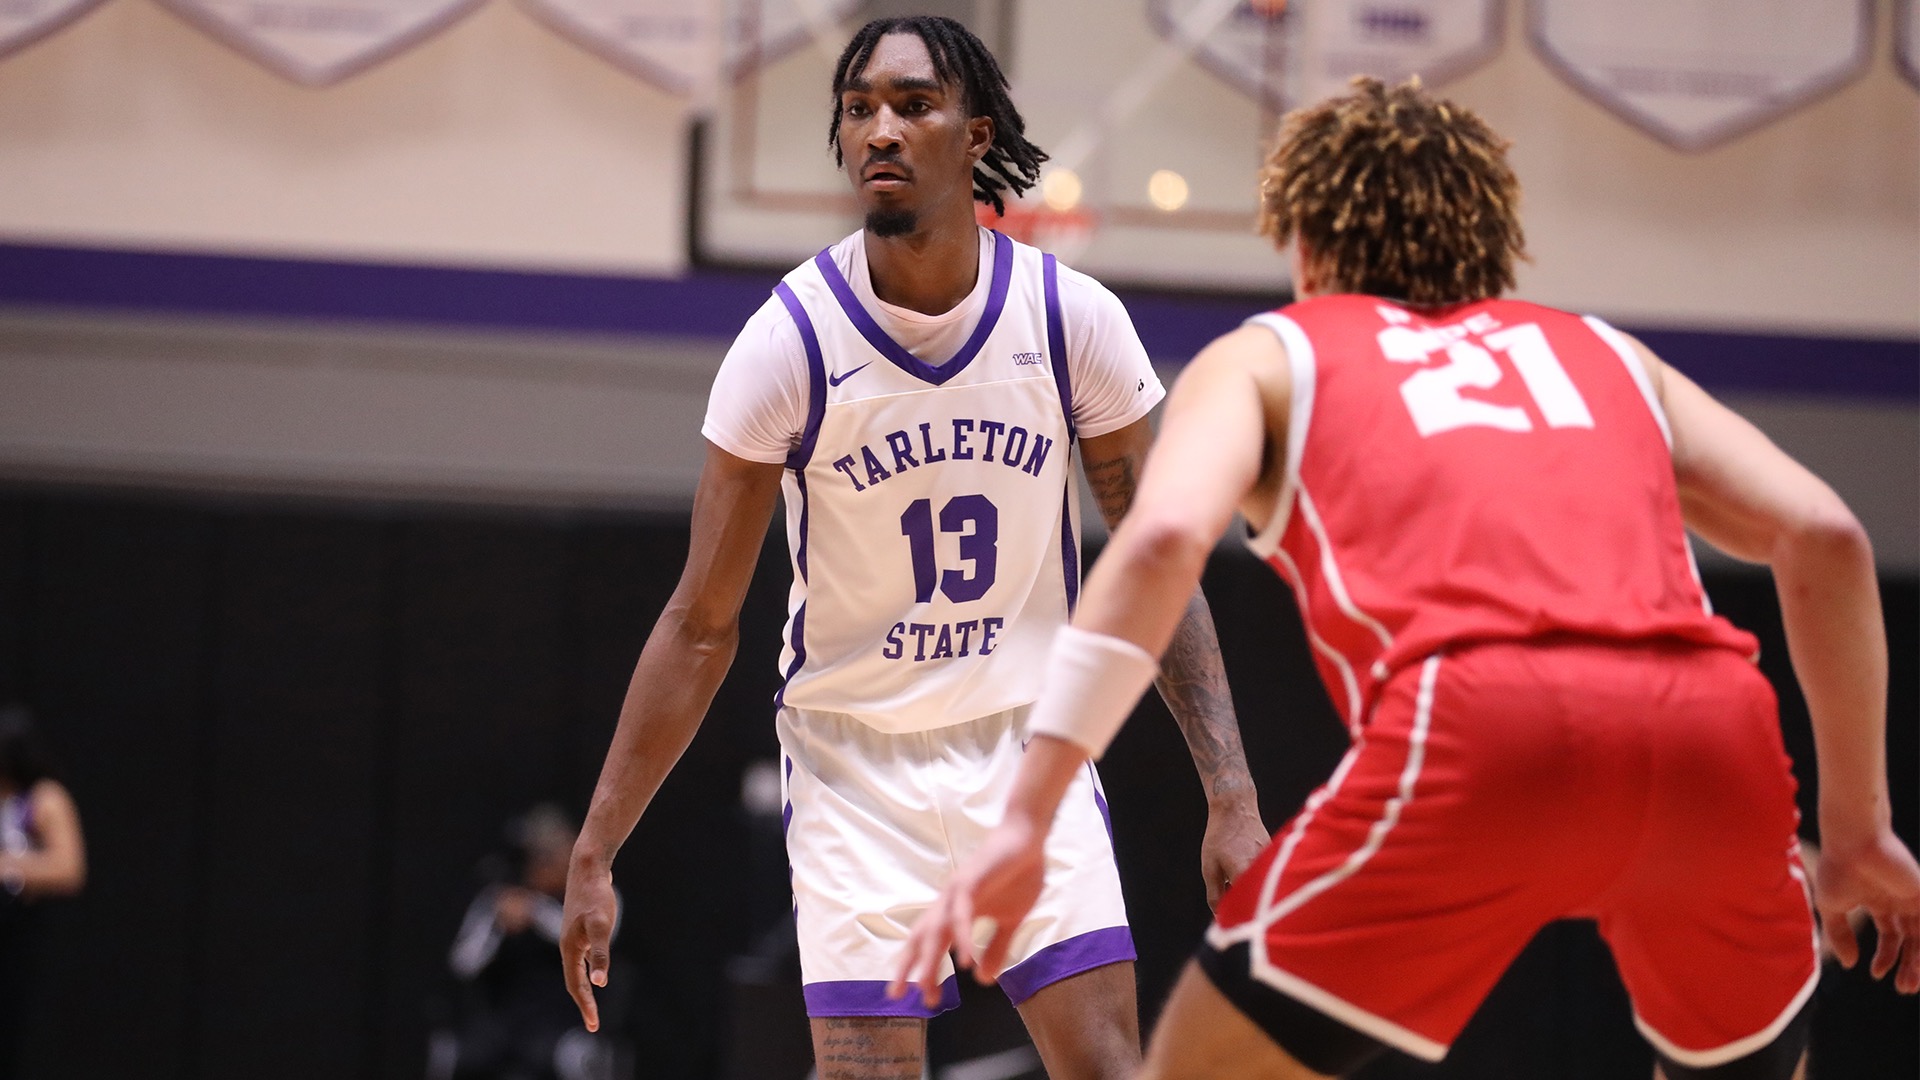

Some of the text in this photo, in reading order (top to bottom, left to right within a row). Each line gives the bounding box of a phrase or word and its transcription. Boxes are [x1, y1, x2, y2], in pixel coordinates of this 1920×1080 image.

[1012, 352, 1042, 366] WAC
[1376, 322, 1596, 438] 21
[832, 418, 1053, 492] TARLETON
[900, 494, 998, 604] 13
[883, 617, 1004, 662] STATE
